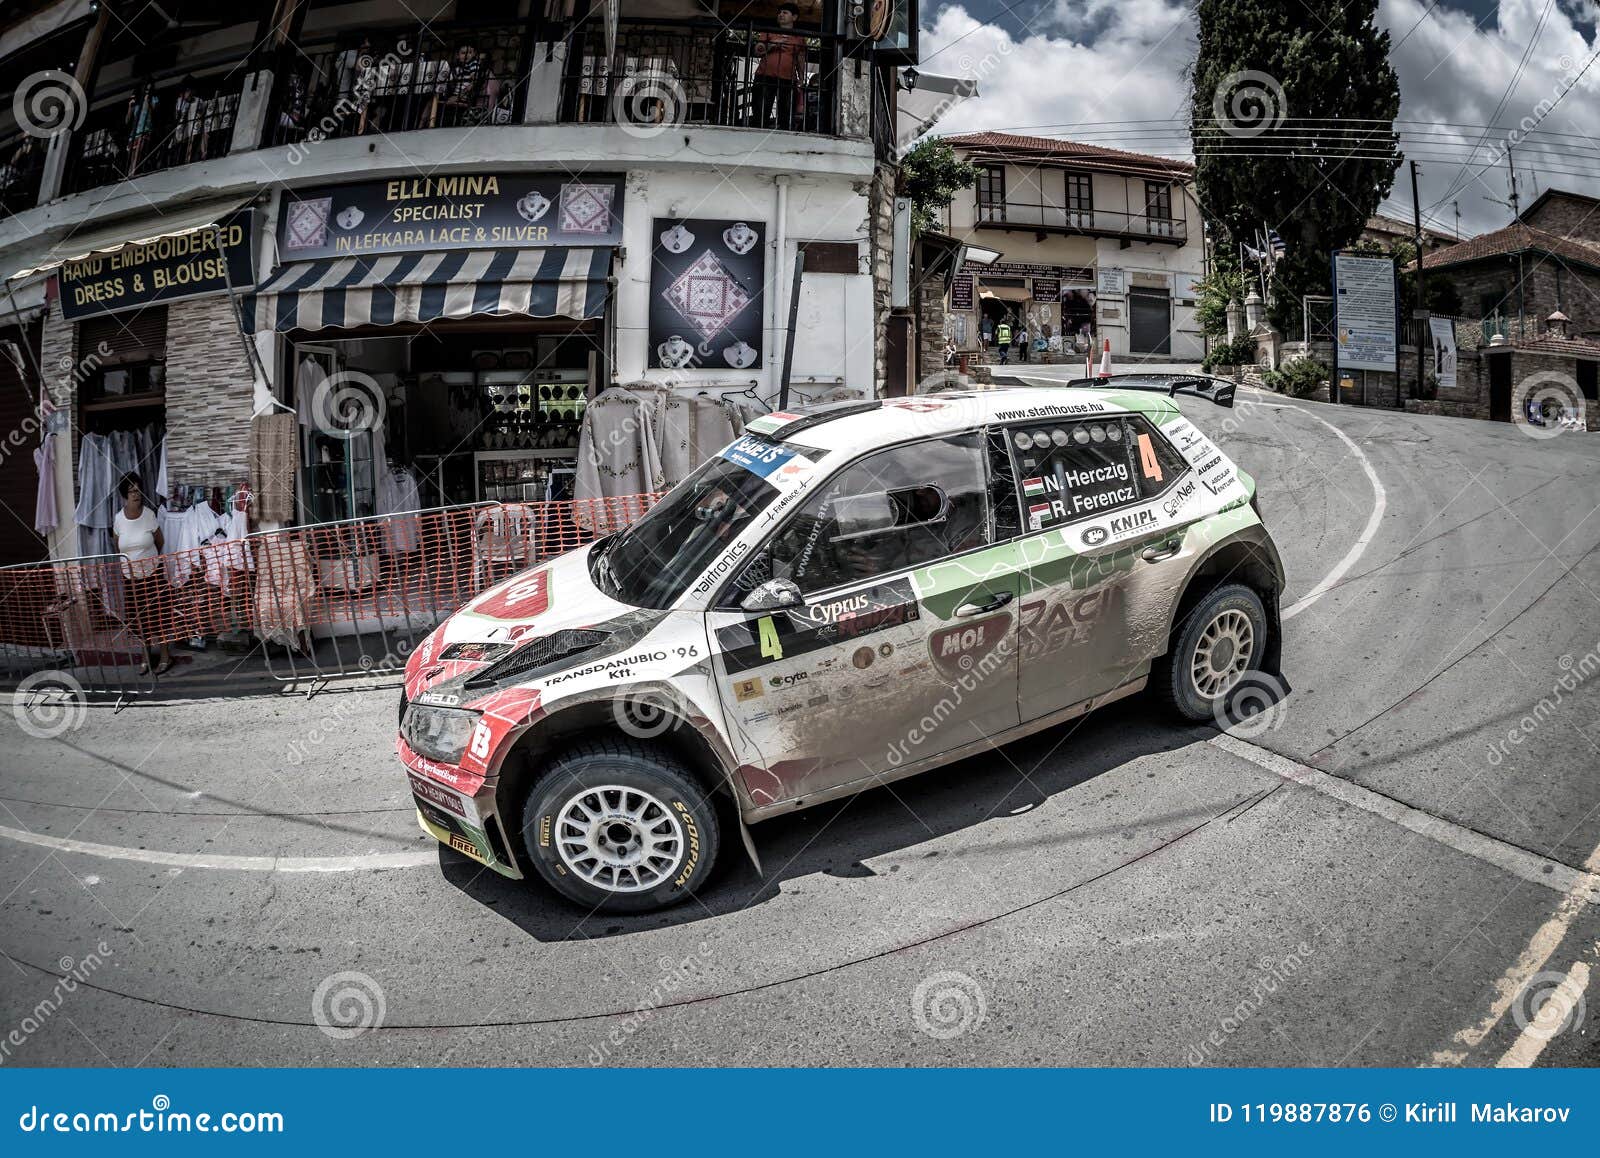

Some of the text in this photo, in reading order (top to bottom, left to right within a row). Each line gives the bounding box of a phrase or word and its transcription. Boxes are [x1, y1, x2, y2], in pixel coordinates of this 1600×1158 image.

[386, 176, 500, 202] ELLI MINA
[393, 203, 485, 224] SPECIALIST
[61, 226, 244, 282] HAND EMBROIDERED
[335, 226, 549, 252] IN LEFKARA LACE & SILVER
[74, 257, 229, 307] DRESS & BLOUSE
[995, 402, 1105, 424] www.staffhouse.hu
[1137, 433, 1163, 482] 4
[1197, 455, 1222, 476] AUSZER
[1043, 462, 1128, 492] N. Herczig
[1051, 487, 1135, 518] R. Ferencz
[1163, 480, 1196, 514] CarNet
[1110, 509, 1157, 534] KNIPL
[809, 594, 869, 625] Cyprus
[758, 617, 784, 660] 4
[543, 645, 698, 687] TRANSDANUBIO '96
[608, 668, 637, 680] Kft.
[784, 671, 809, 685] cyta
[671, 801, 702, 887] SCORPION
